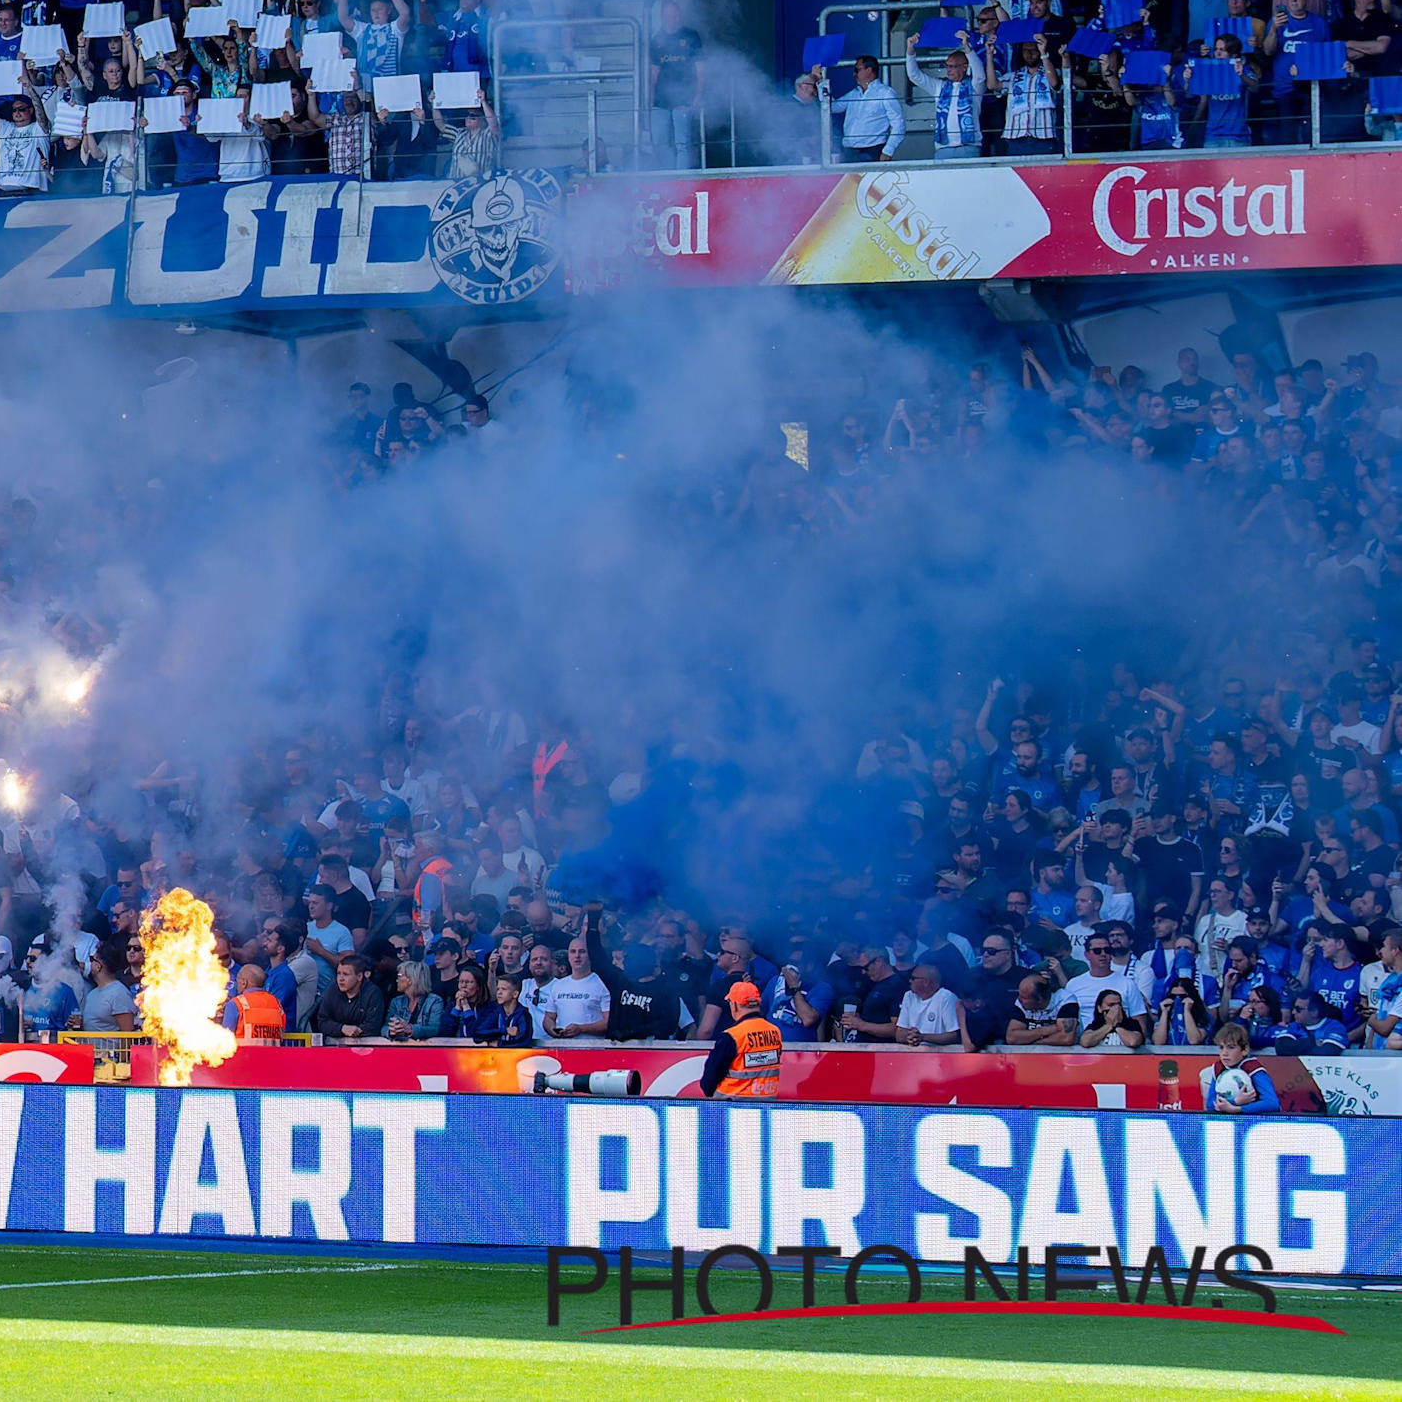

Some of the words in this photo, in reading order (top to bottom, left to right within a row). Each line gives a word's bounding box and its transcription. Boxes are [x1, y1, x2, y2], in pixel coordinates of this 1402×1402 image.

[856, 171, 980, 279] Cristal
[1092, 166, 1306, 256] Cristal
[871, 232, 911, 274] ALKEN
[1164, 253, 1235, 268] ALKEN
[1347, 1069, 1380, 1101] KLAS
[64, 1087, 447, 1243] HART
[565, 1103, 866, 1260] PUR
[915, 1113, 1347, 1275] SANG
